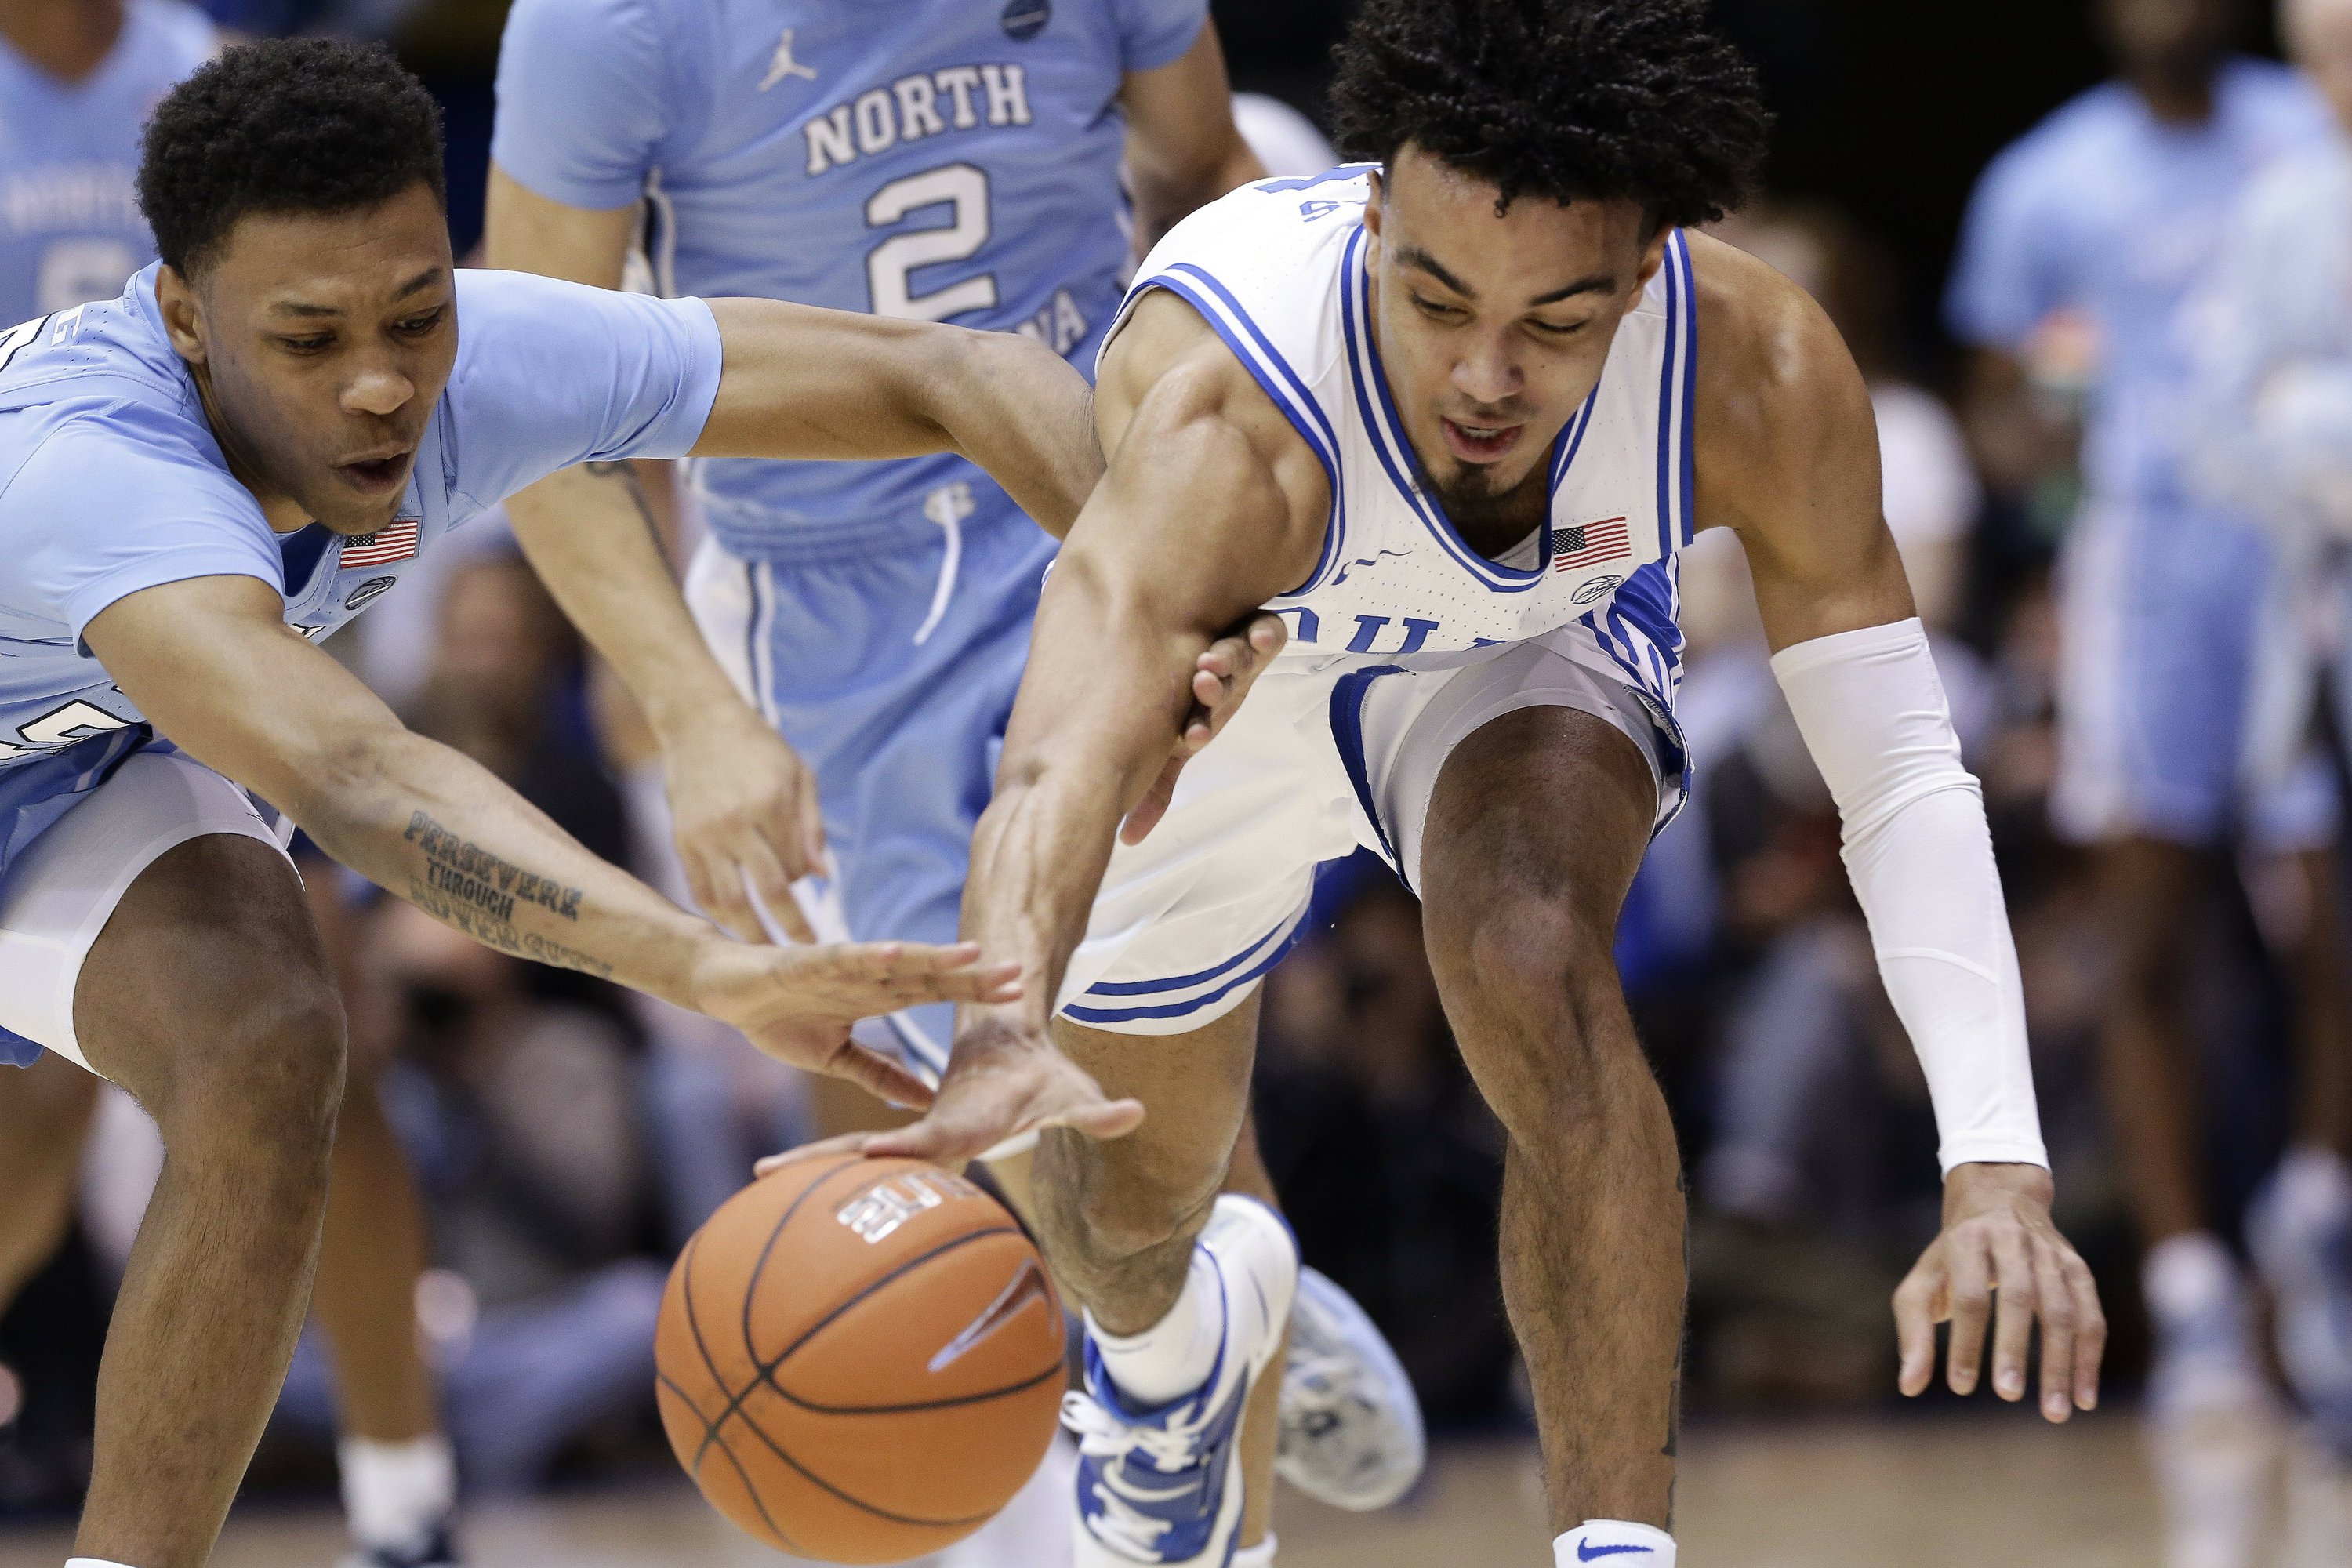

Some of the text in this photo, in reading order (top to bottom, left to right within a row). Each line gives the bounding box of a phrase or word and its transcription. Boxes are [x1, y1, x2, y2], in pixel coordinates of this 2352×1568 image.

[804, 64, 1032, 175] NORTH
[866, 162, 997, 321] 2
[404, 810, 582, 920] PERSEVERE
[427, 856, 514, 920] THROUGH
